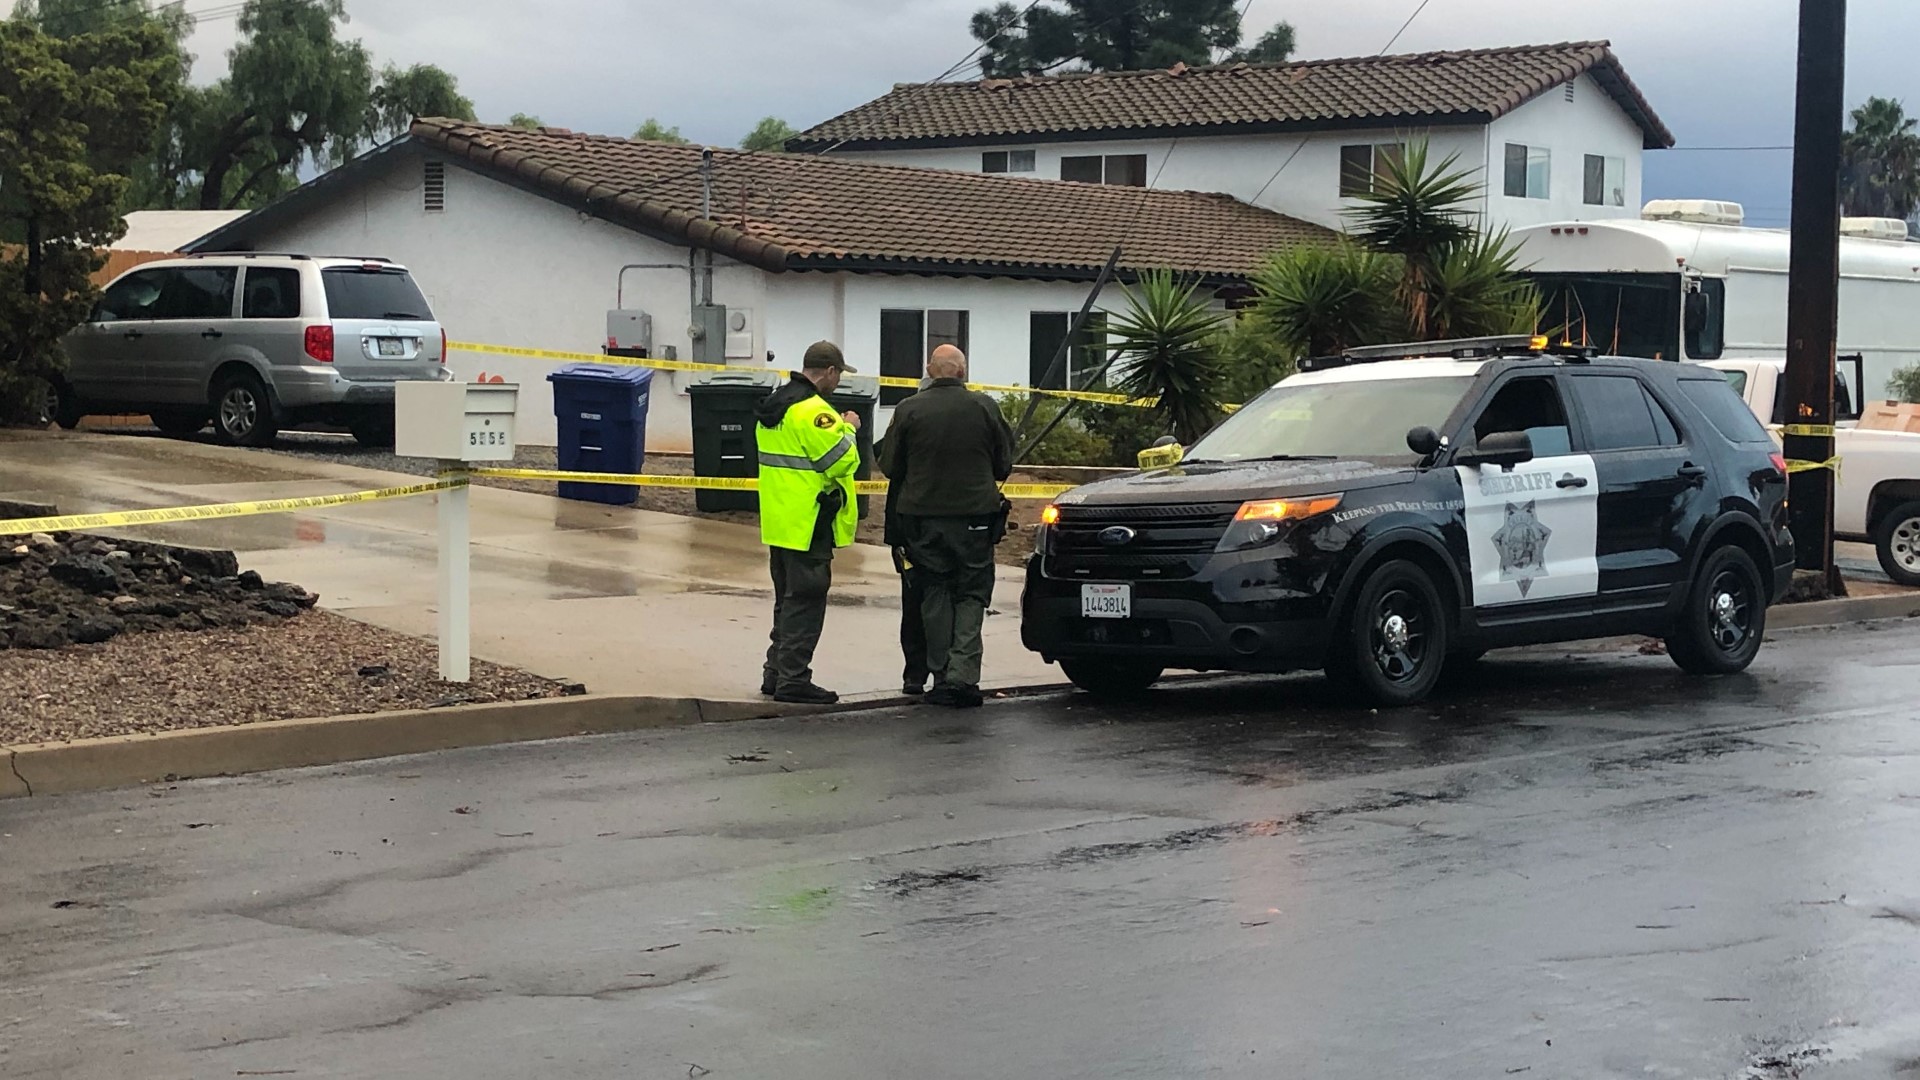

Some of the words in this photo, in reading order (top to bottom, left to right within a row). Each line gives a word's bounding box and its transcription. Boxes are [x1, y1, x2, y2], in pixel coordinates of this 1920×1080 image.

[1479, 472, 1552, 496] SHERIFF
[162, 508, 185, 519] LINE
[181, 507, 198, 517] DO
[195, 505, 215, 516] NOT
[213, 503, 242, 515] CROSS
[22, 521, 44, 532] LINE
[43, 519, 60, 530] DO
[58, 518, 77, 529] NOT
[76, 515, 108, 528] CROSS
[1084, 596, 1127, 613] 1443814
